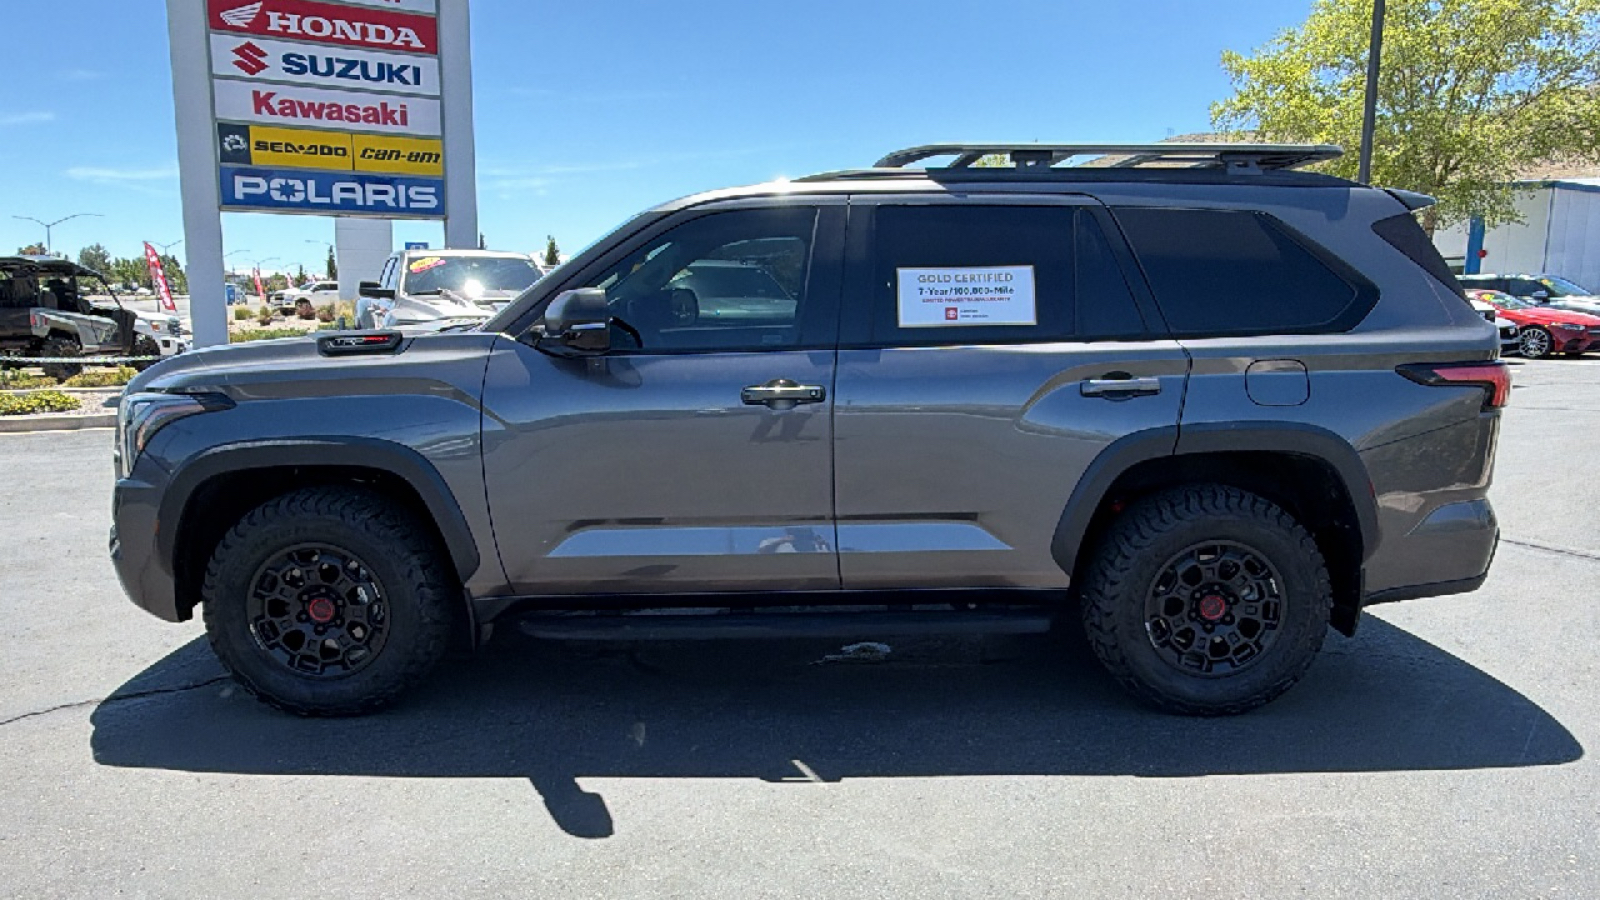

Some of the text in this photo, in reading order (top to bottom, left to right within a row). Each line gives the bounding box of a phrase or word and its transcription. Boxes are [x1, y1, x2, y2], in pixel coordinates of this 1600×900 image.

[265, 10, 426, 49] HONDA
[281, 52, 421, 86] SUZUKI
[252, 90, 409, 126] Kawasaki
[233, 175, 438, 209] POLARIS
[918, 272, 1013, 283] GOLD CERTIFIED
